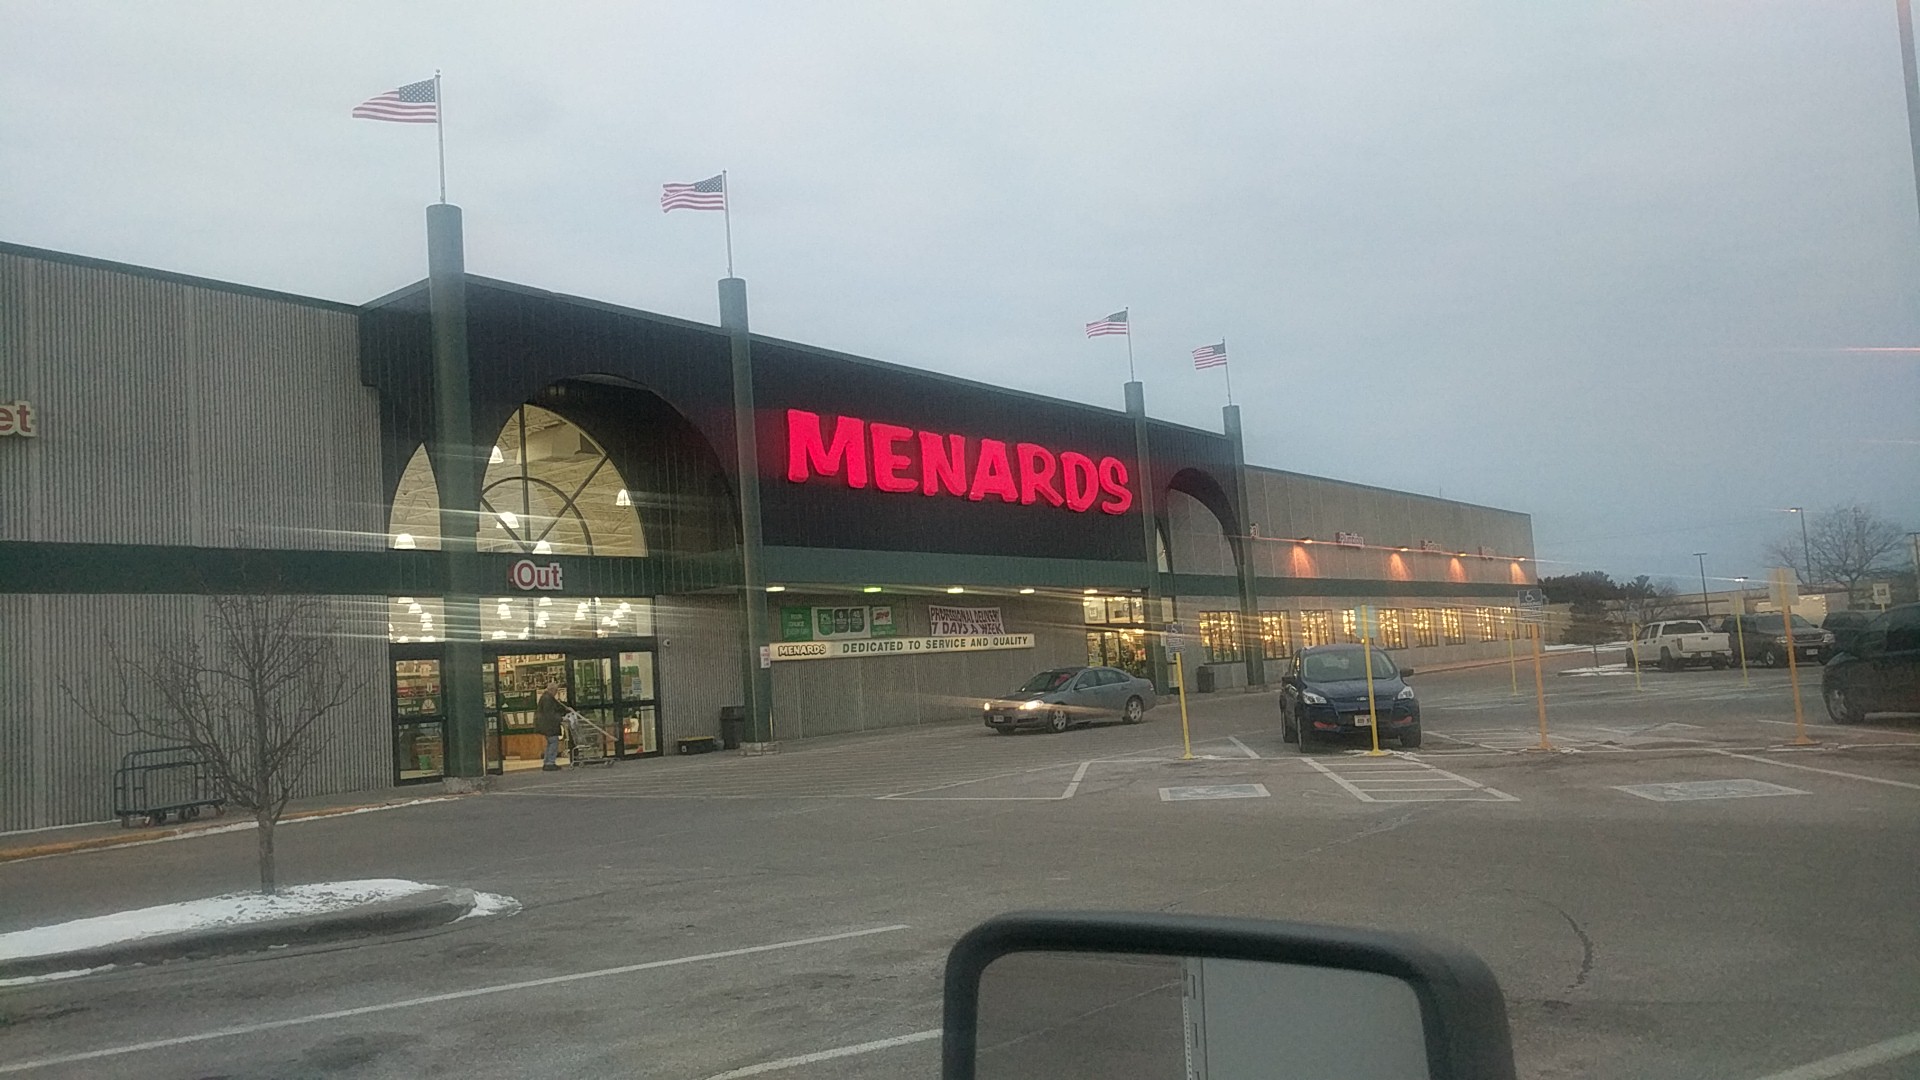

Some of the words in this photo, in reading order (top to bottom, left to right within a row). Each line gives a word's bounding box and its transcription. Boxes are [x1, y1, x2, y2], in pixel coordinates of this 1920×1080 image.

[787, 409, 1133, 514] MENARDS
[515, 560, 562, 589] Out
[931, 622, 939, 634] 7
[942, 622, 969, 635] DAYS
[970, 623, 979, 635] A
[979, 622, 1004, 635] WEEK
[777, 644, 827, 657] MENARDS
[842, 641, 904, 653] DEDICATED
[908, 640, 921, 650] TO
[925, 638, 966, 650] SERVICE
[970, 637, 989, 648] AND
[992, 636, 1028, 647] QUALITY
